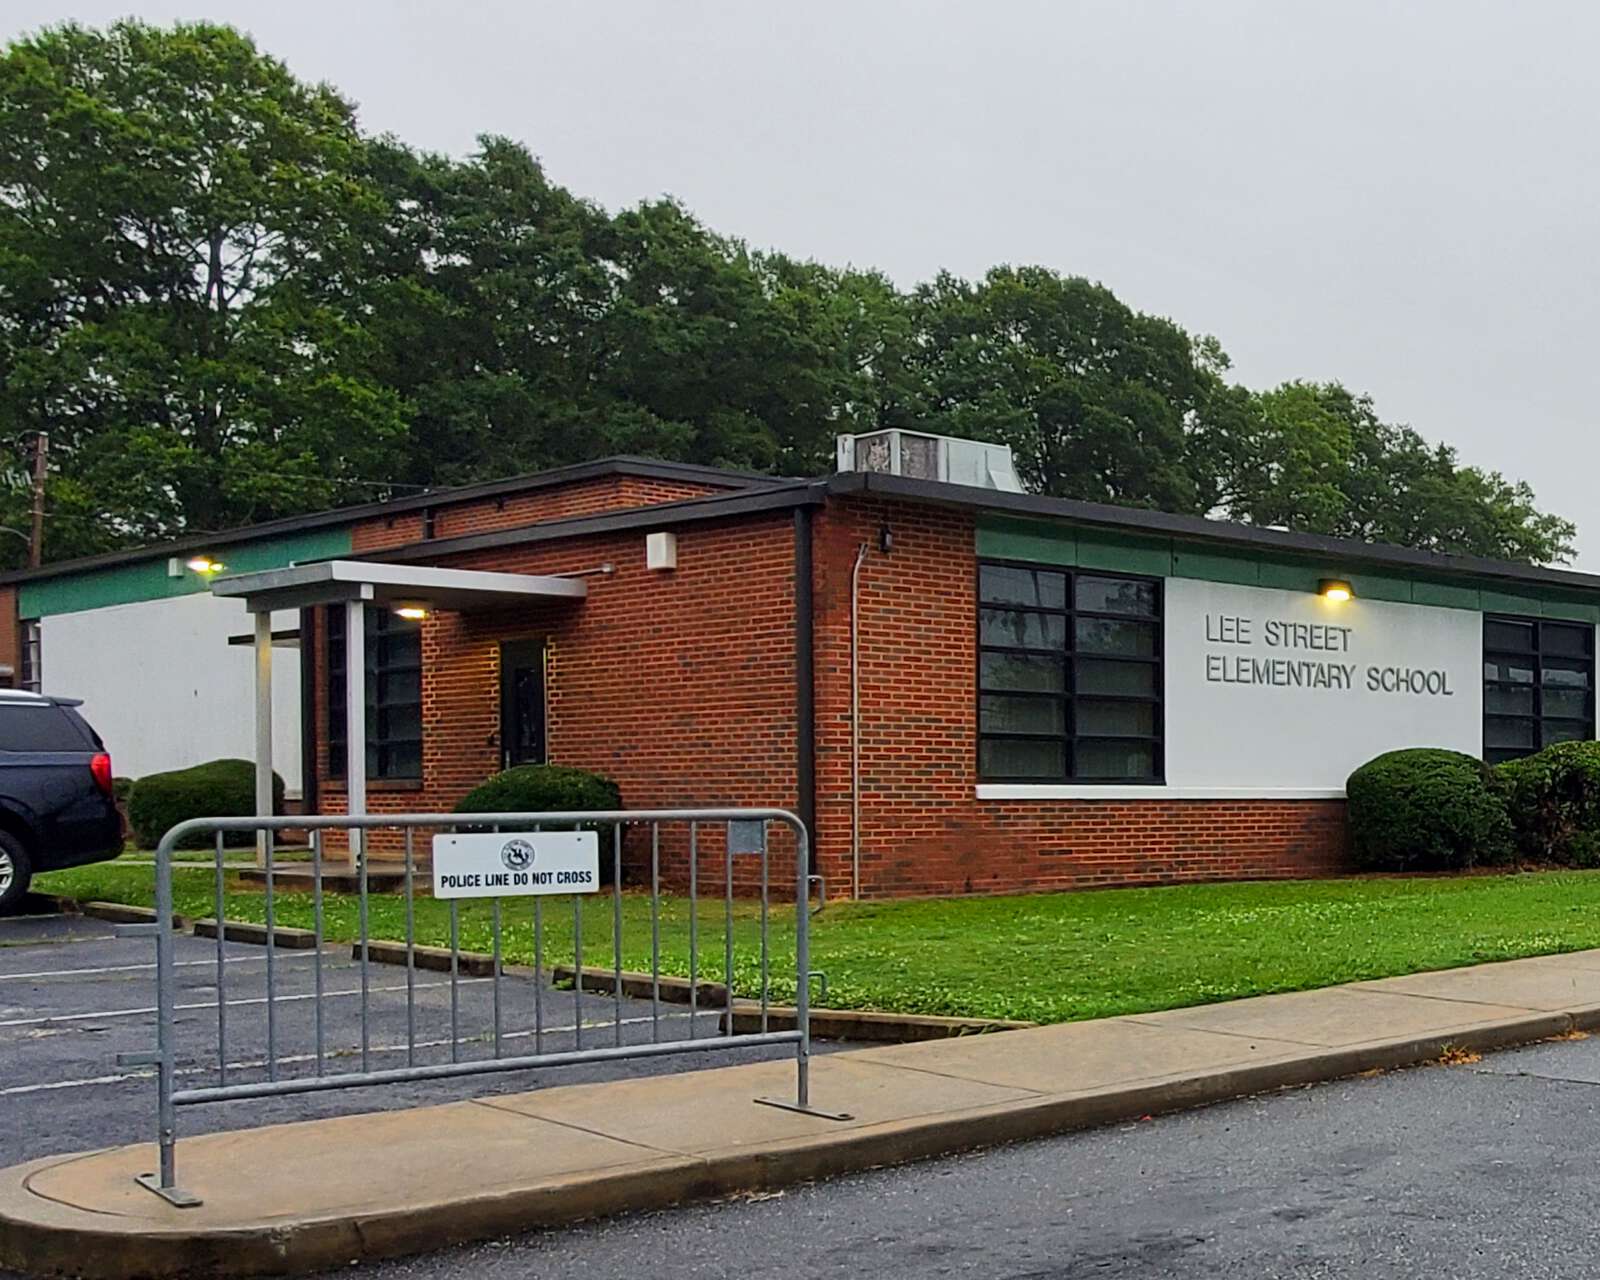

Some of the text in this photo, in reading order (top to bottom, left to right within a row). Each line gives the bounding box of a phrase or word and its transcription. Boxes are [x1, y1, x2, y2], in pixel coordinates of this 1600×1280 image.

[1206, 614, 1352, 652] LEE STREET
[1206, 654, 1454, 696] ELEMENTARY SCHOOL
[441, 871, 592, 888] POLICE LINE DO NOT CROSS
